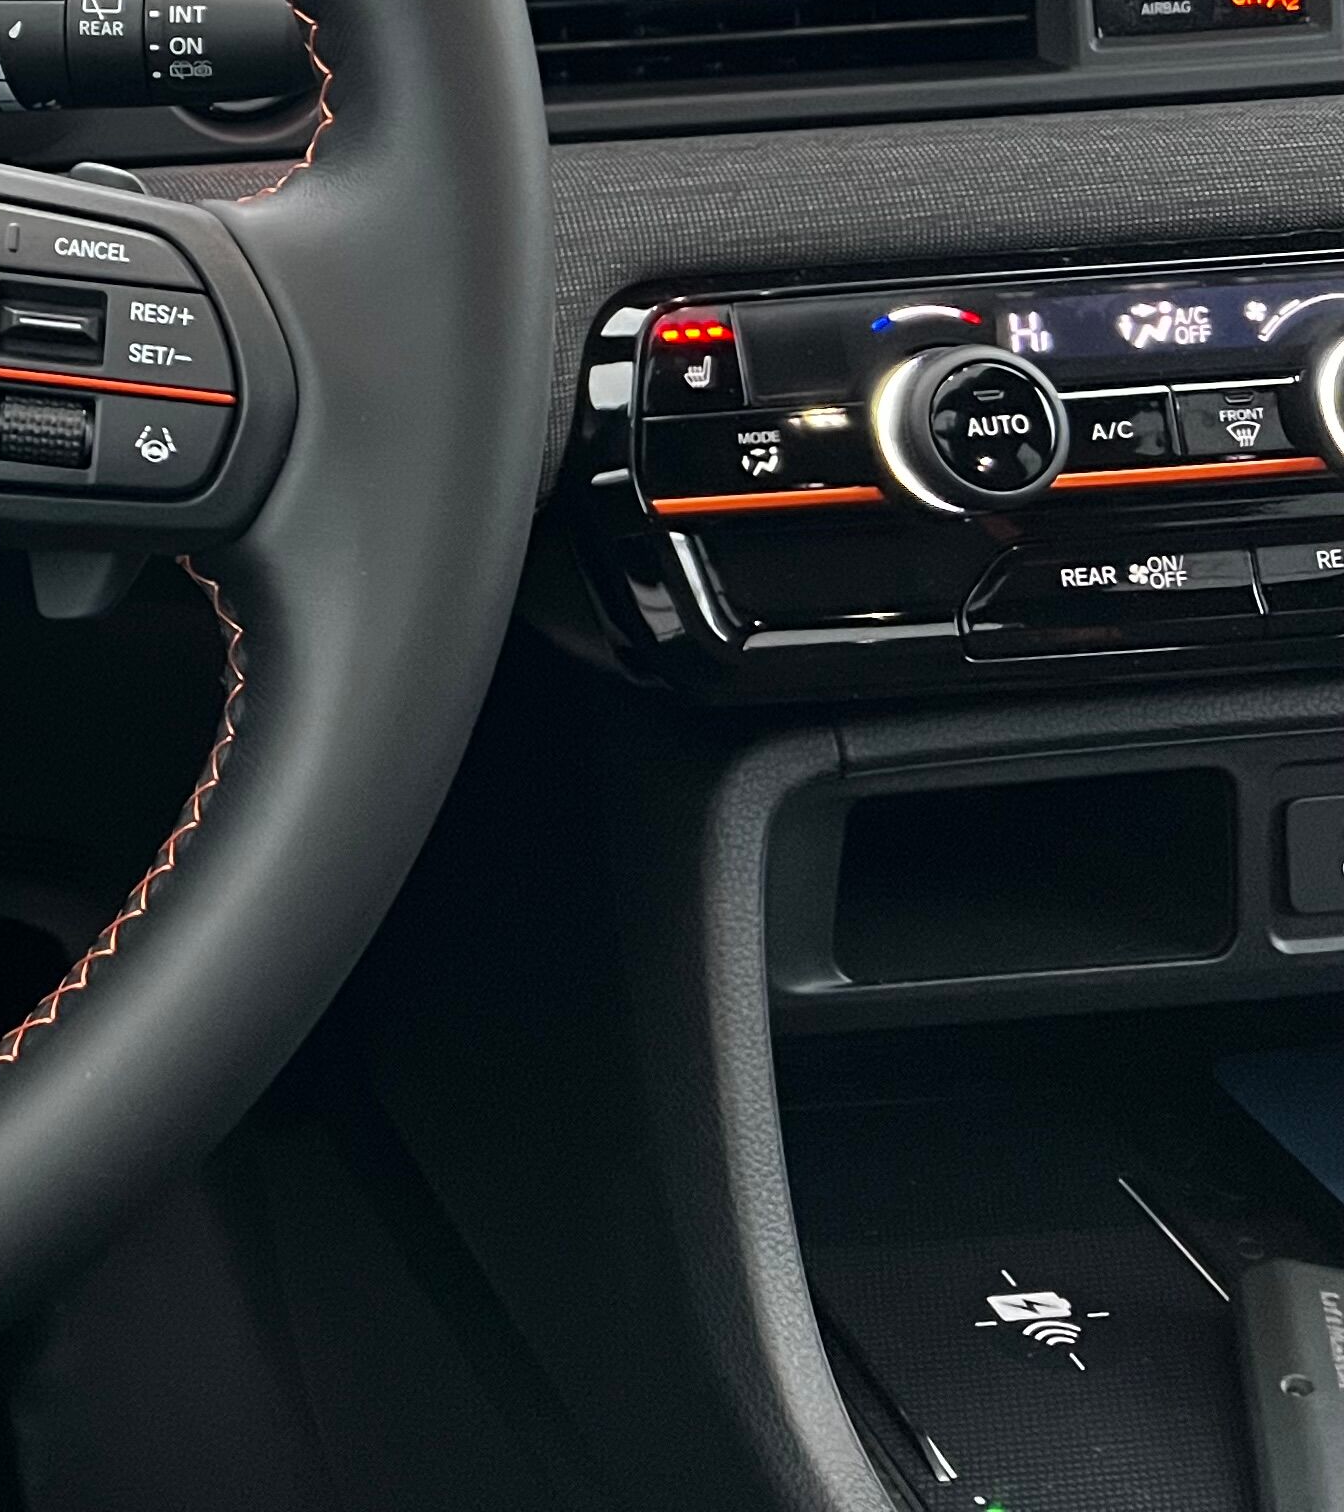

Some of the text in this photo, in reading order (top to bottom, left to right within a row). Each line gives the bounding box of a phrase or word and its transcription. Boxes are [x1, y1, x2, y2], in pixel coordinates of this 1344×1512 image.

[169, 5, 206, 23] INT
[1141, 1, 1191, 15] AIRBAG
[79, 21, 124, 36] REAR
[169, 37, 203, 55] ON
[54, 237, 130, 262] CANCEL
[129, 301, 194, 326] RES/+
[1174, 306, 1209, 326] A/C
[1176, 324, 1212, 345] OFF
[1219, 407, 1264, 422] FRONT
[966, 410, 1030, 439] AUTO
[1091, 420, 1134, 441] A/C
[738, 431, 781, 445] MODE
[1146, 554, 1185, 573] ON/
[1060, 566, 1188, 590] REAR OFF
